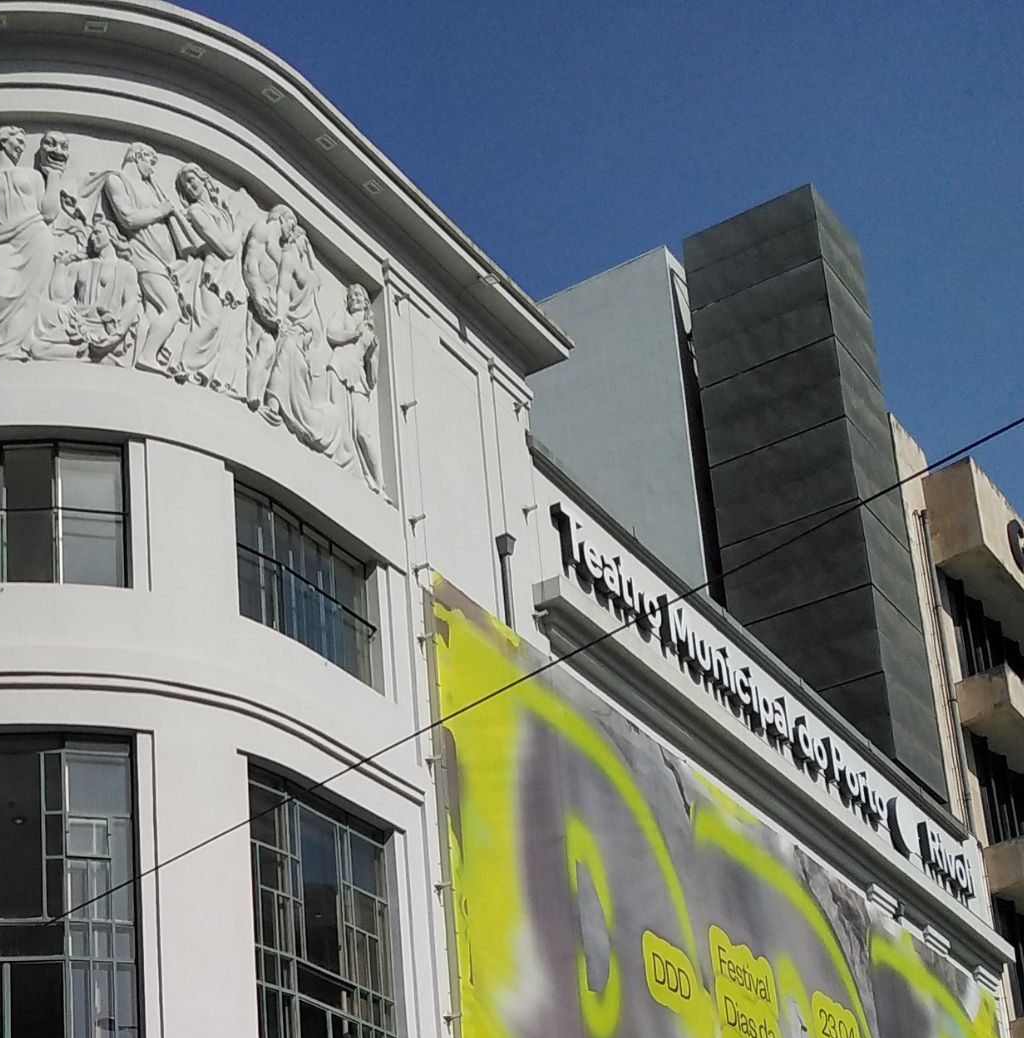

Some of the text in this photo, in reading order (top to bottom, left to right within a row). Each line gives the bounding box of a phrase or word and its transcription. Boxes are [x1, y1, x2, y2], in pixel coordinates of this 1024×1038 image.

[550, 502, 976, 903] Teatro Municipal do Porto Rivoli
[652, 953, 692, 1000] DDD
[717, 945, 772, 1004] Festival
